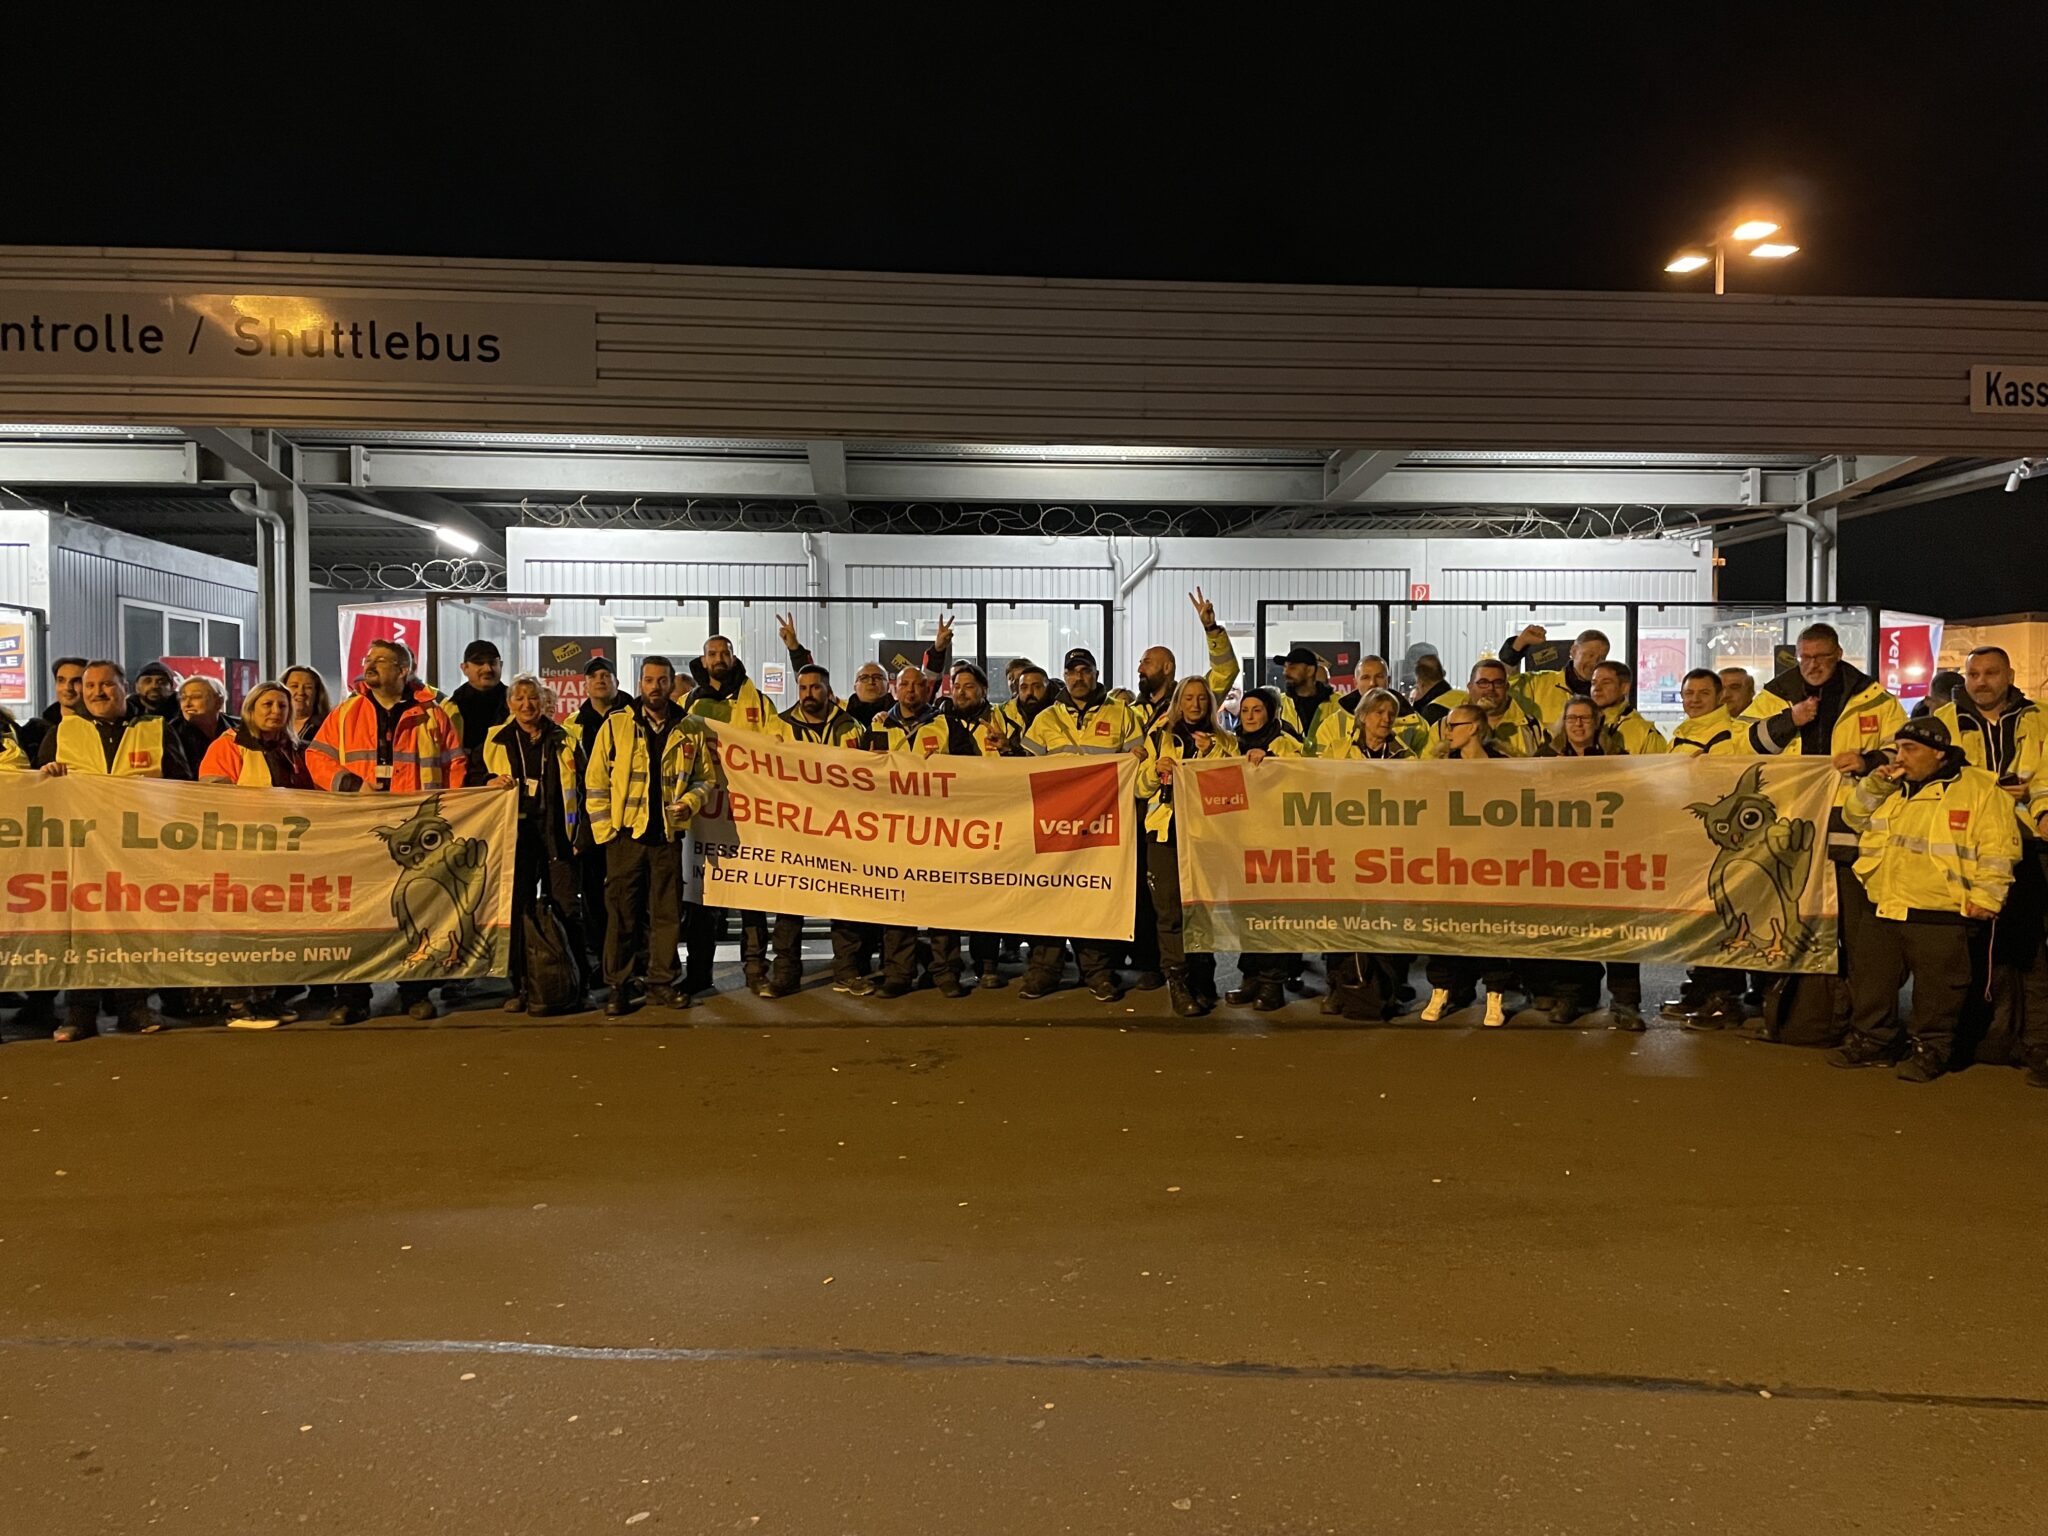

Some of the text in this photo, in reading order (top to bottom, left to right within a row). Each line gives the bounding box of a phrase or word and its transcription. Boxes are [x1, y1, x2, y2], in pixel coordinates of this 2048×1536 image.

[1, 313, 164, 354] ntrolle
[233, 317, 500, 363] Shuttlebus
[1986, 371, 2048, 407] Kass
[706, 736, 875, 792] SCHLUSS
[889, 770, 957, 799] MIT
[700, 784, 1003, 851] ÜBERLASTUNG!
[1204, 793, 1244, 806] ver.di
[1282, 788, 1625, 829] Mehr Lohn?
[0, 806, 312, 852] ehr Lohn?
[1039, 813, 1113, 837] ver.di
[692, 864, 905, 902] IN DER LUFTSICHERHEIT!
[694, 841, 1112, 891] BESSERE RAHMEN- UND ARBEITSBEDINGUNGEN
[1244, 847, 1668, 891] Mit Sicherheit!
[6, 871, 353, 914] Sicherheit!
[1246, 916, 1669, 942] Tarifrunde Wach- & Sicherheitsgewerbe NRW
[63, 949, 81, 964] &
[86, 947, 297, 968] Sicherheitsgewerbe
[303, 946, 352, 962] NRW
